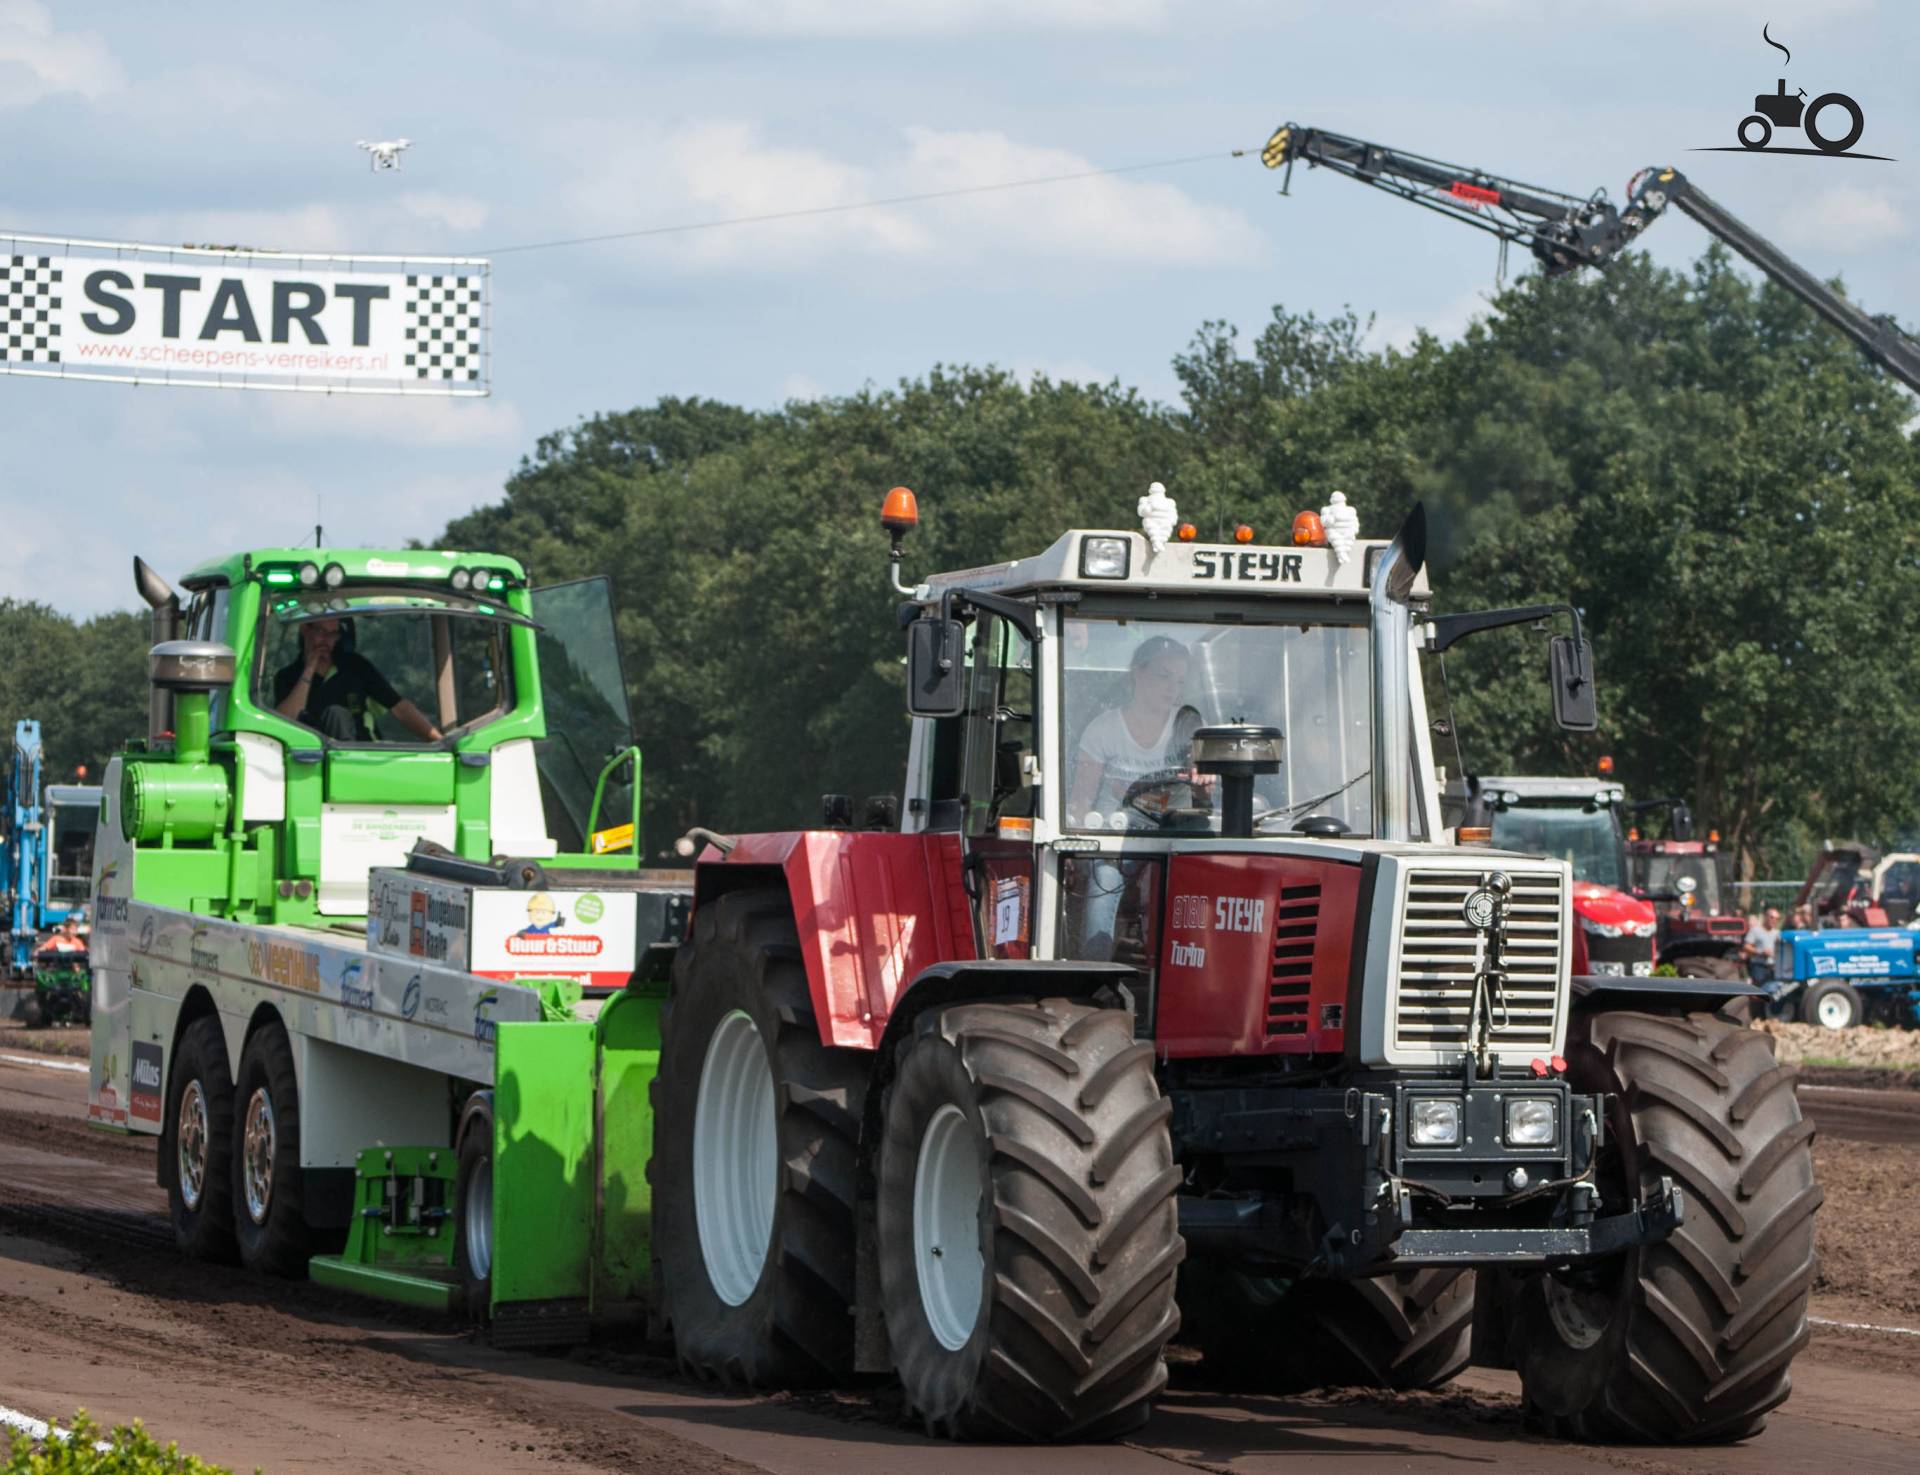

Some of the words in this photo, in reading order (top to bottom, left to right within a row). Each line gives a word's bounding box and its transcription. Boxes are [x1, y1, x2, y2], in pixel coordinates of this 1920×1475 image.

[80, 269, 390, 347] START
[77, 343, 389, 372] www.scheepens-verreikers.nl
[1192, 551, 1303, 582] STEYR
[1172, 894, 1209, 929] 8180
[1214, 896, 1265, 933] STEYR
[1170, 940, 1206, 969] Turbo
